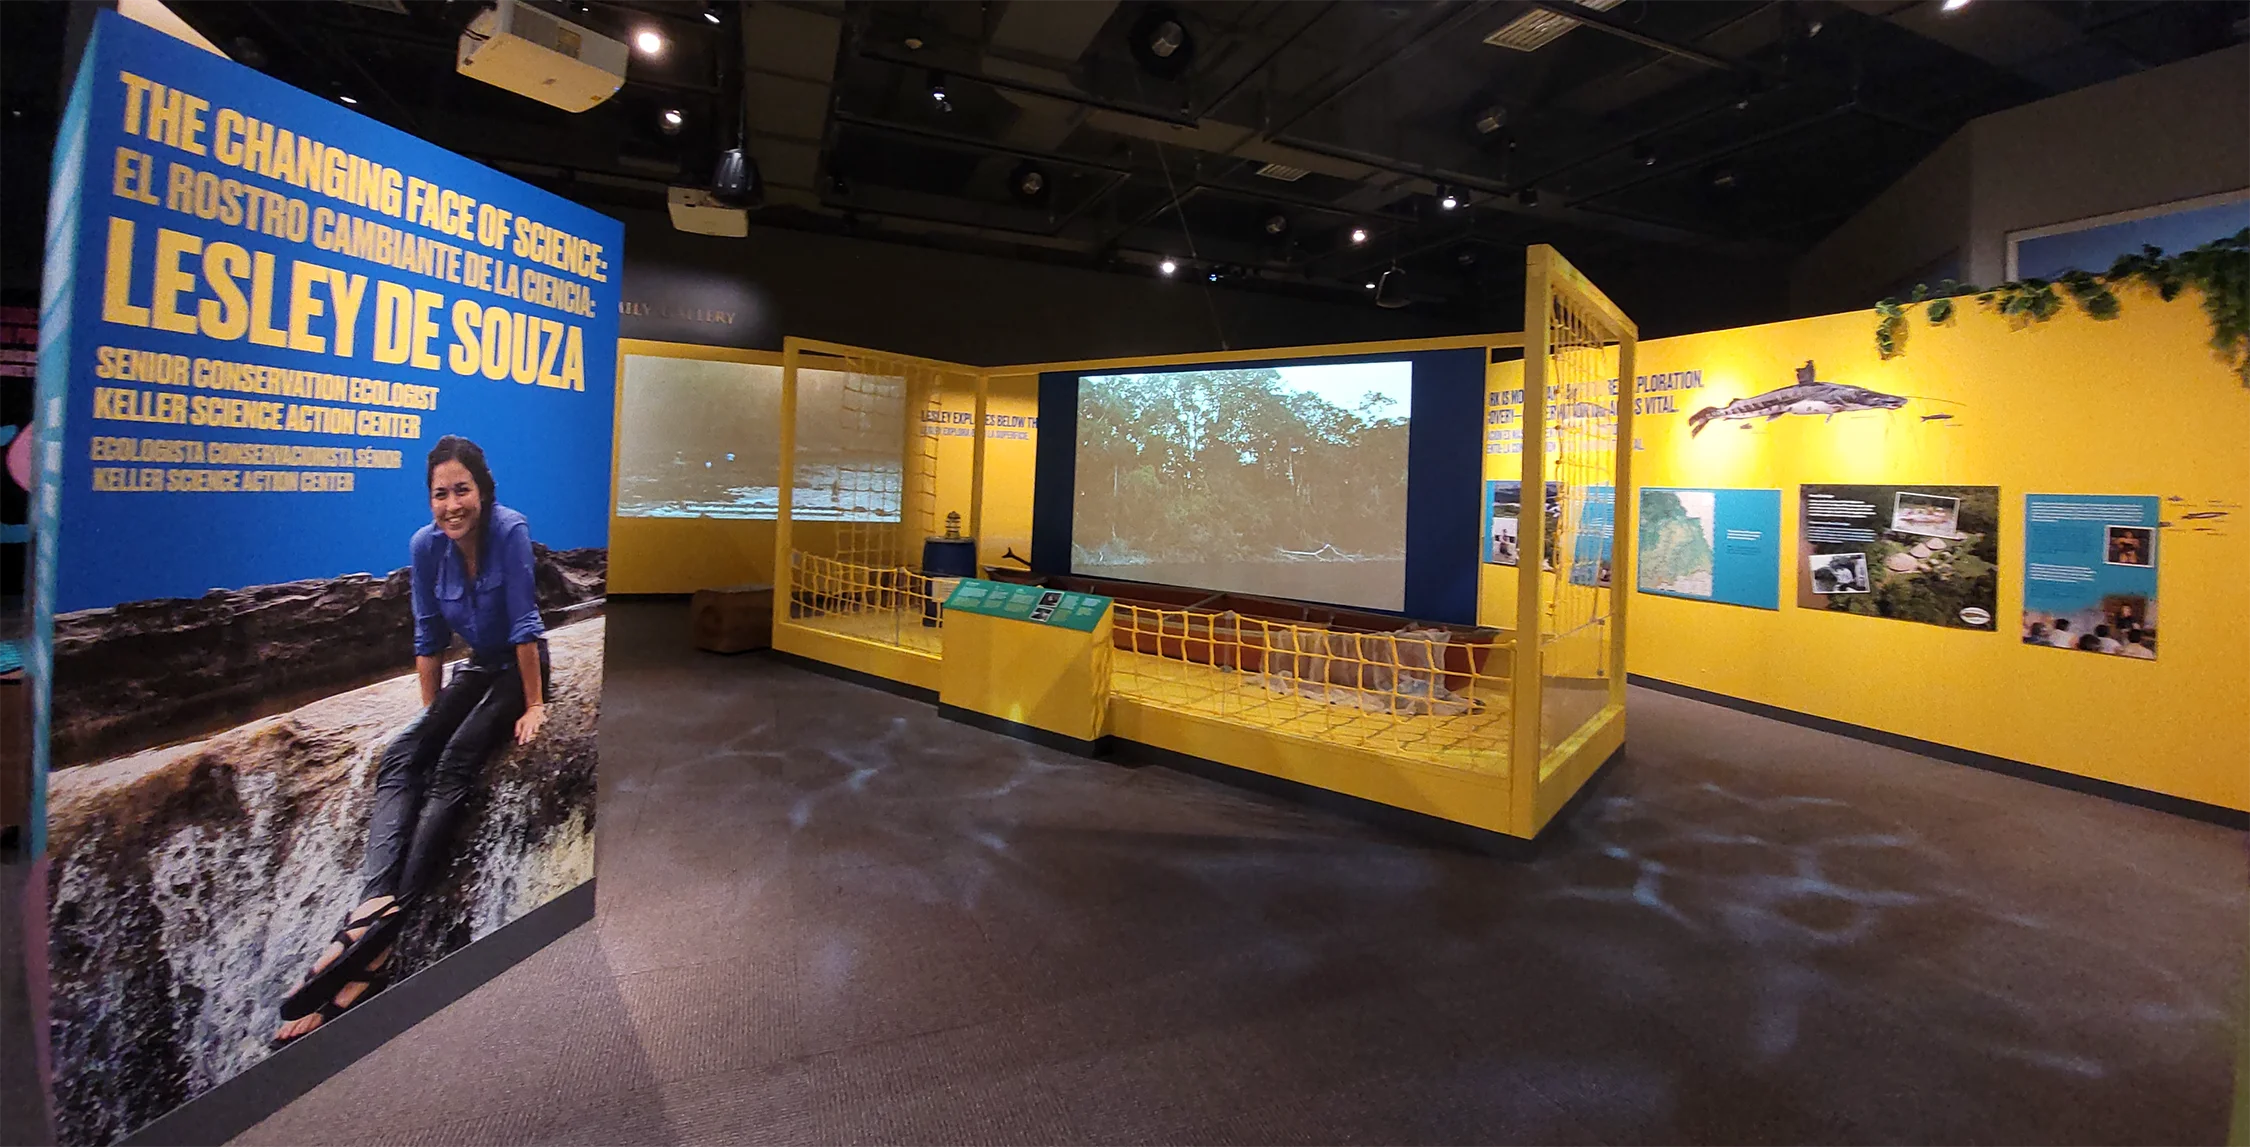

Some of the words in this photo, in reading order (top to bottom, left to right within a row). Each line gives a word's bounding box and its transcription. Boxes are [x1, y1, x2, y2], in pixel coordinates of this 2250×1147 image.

[120, 70, 210, 156] THE
[214, 108, 403, 218] CHANGING
[406, 176, 476, 241] FACE
[477, 203, 512, 250] OF
[513, 216, 608, 282] SCIENCE:
[113, 146, 160, 205] EL
[167, 162, 309, 243] ROSTRO
[313, 207, 462, 284] CAMBIANTE
[463, 251, 493, 292] DE
[494, 260, 519, 298] LA
[522, 269, 596, 318] CIENCIA:
[102, 216, 368, 357] LESLEY
[373, 280, 444, 370] DE
[449, 299, 585, 391] SOUZA
[96, 346, 190, 386] SENIOR
[193, 358, 348, 401] CONSERVATION
[349, 377, 440, 410] ECOLOGIST
[1635, 370, 1704, 393] PLORATION.
[92, 387, 188, 424] KELLER
[190, 396, 284, 431] SCIENCE
[285, 403, 355, 435] ACTION
[357, 410, 421, 439] CENTER
[997, 414, 1025, 428] BELOW
[1027, 417, 1038, 428] TH
[1645, 396, 1679, 414] VITAL.
[90, 436, 205, 463] ECOLOGISTA
[208, 442, 354, 467] CONSERVACIONISTA
[92, 467, 164, 491] KELLER
[165, 469, 241, 491] SCIENCE
[241, 470, 299, 492] ACTION
[301, 472, 354, 492] CENTER
